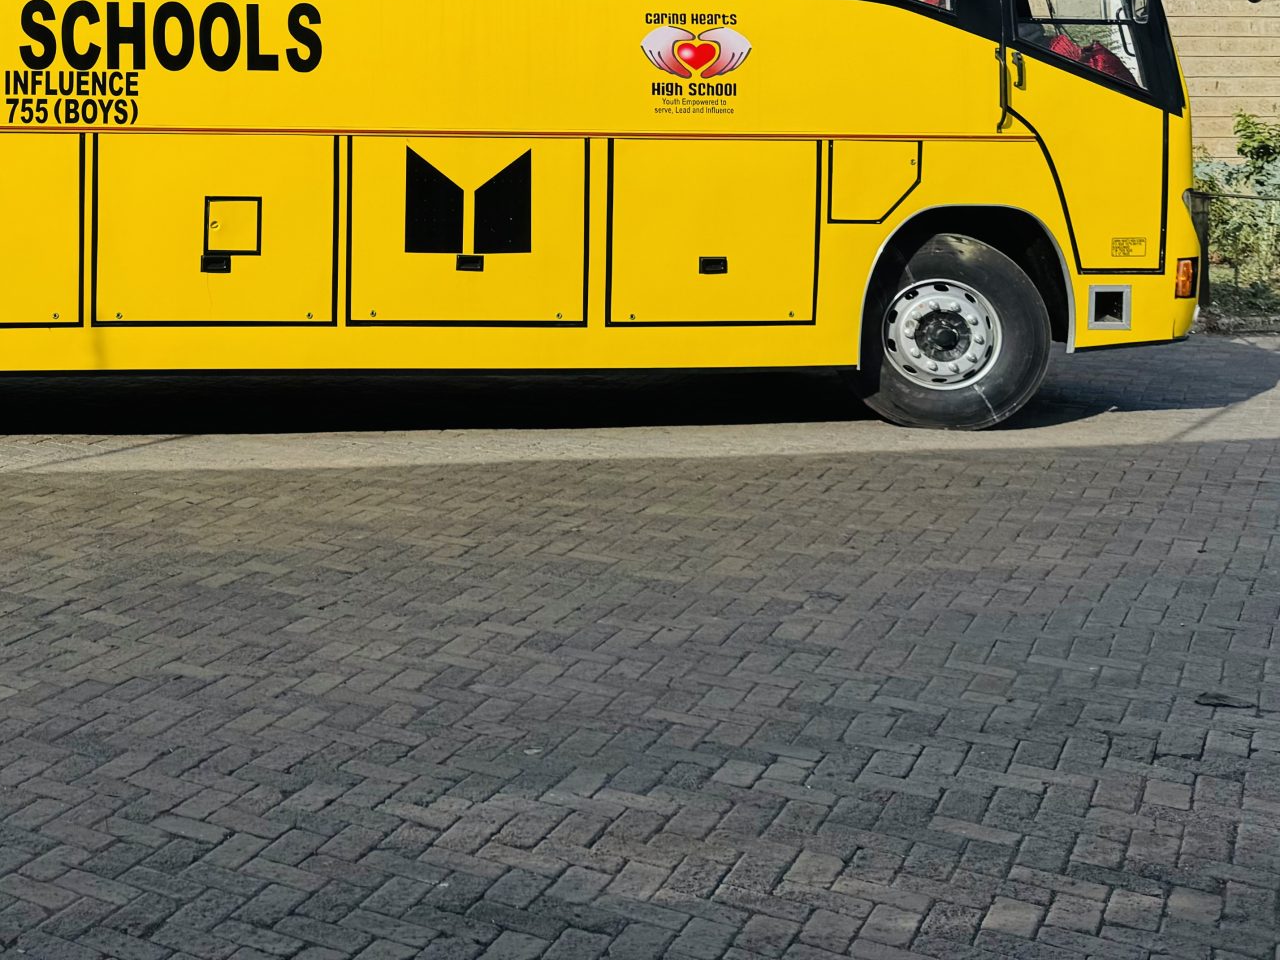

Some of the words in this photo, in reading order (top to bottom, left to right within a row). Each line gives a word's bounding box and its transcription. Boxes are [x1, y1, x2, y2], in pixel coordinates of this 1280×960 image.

[20, 0, 323, 73] SCHOOLS
[5, 70, 139, 97] INFLUENCE
[675, 106, 691, 114] Lead
[681, 97, 719, 107] Empowered
